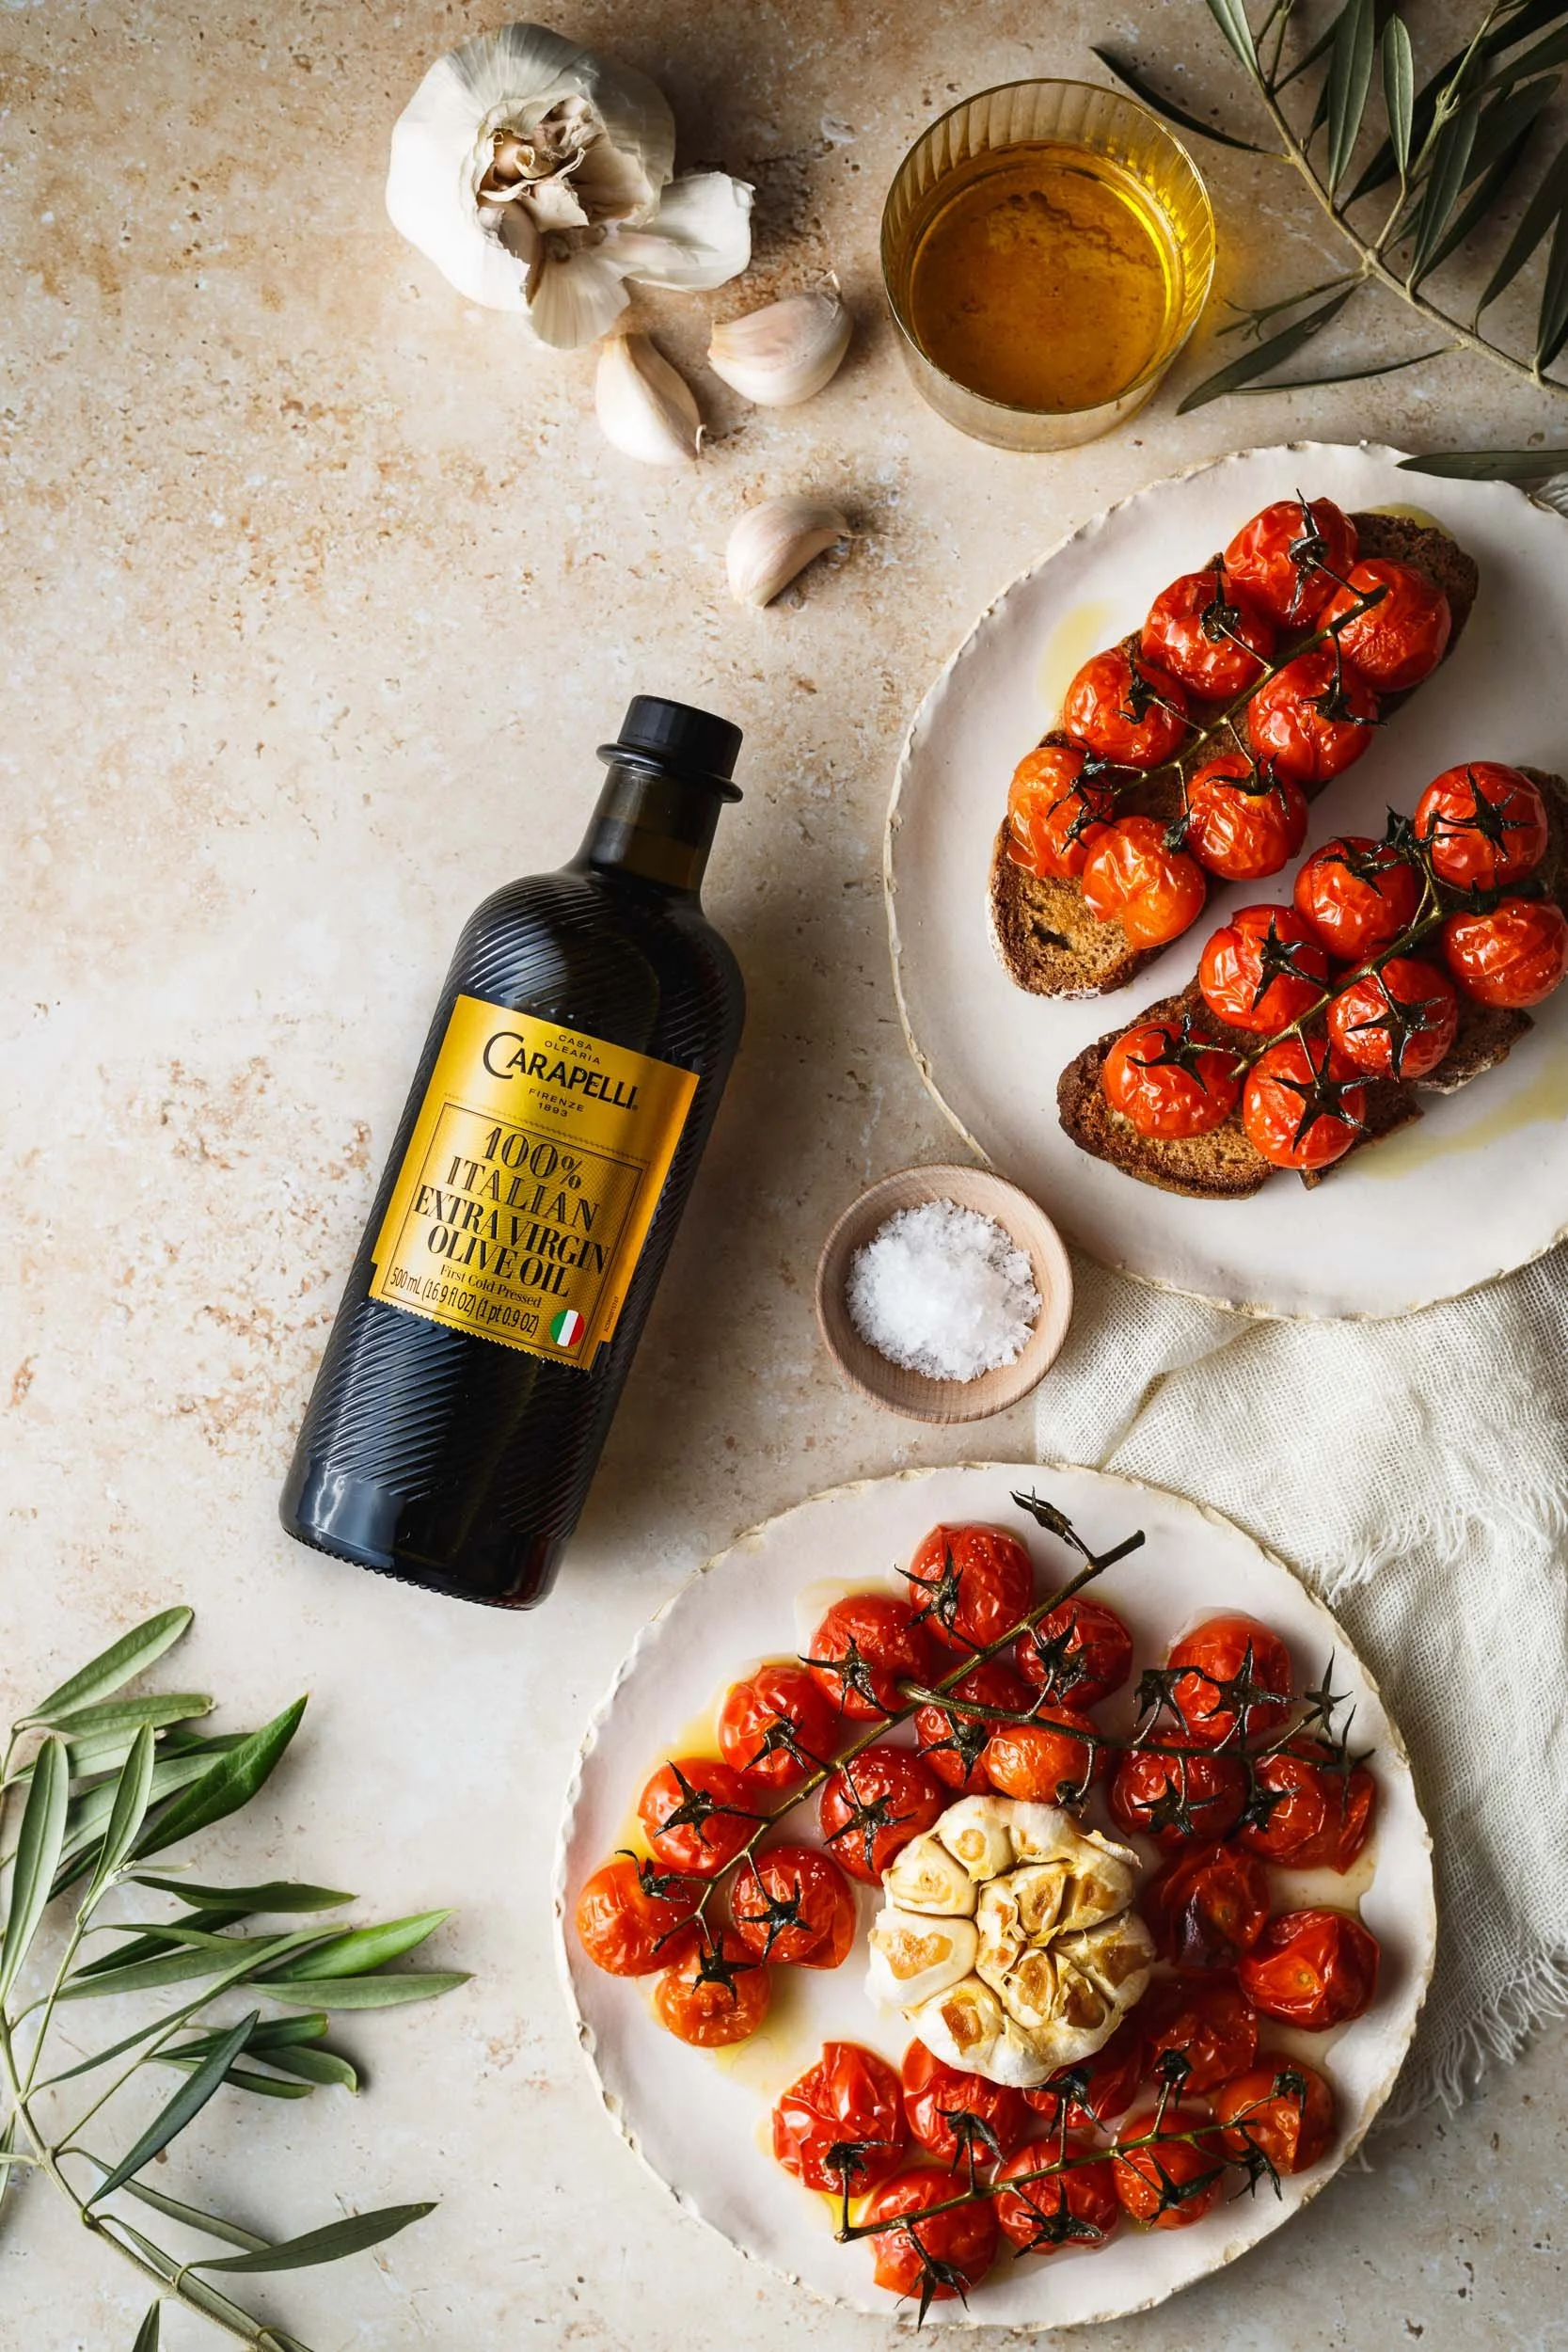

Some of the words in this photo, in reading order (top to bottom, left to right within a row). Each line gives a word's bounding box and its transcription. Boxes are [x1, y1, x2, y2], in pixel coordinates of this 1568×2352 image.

[483, 1031, 639, 1110] CARAPELLI
[544, 1040, 601, 1065] OLEARIA
[559, 1034, 593, 1051] CASA
[529, 1088, 584, 1113] FIRENZE
[538, 1102, 568, 1117] 1893
[482, 1126, 582, 1190] 100%
[444, 1155, 600, 1232] ITALIAN
[413, 1184, 500, 1241] EXTRA
[511, 1216, 611, 1274] VIRGIN
[427, 1225, 518, 1279] OLIVE
[519, 1257, 569, 1297] OIL
[440, 1263, 466, 1282] First
[467, 1275, 495, 1294] Cold
[497, 1282, 543, 1309] Pressed
[390, 1267, 407, 1288] 500
[406, 1276, 422, 1295] mL
[422, 1279, 448, 1302] (16.9
[447, 1287, 457, 1308] fl
[486, 1300, 502, 1325] pt
